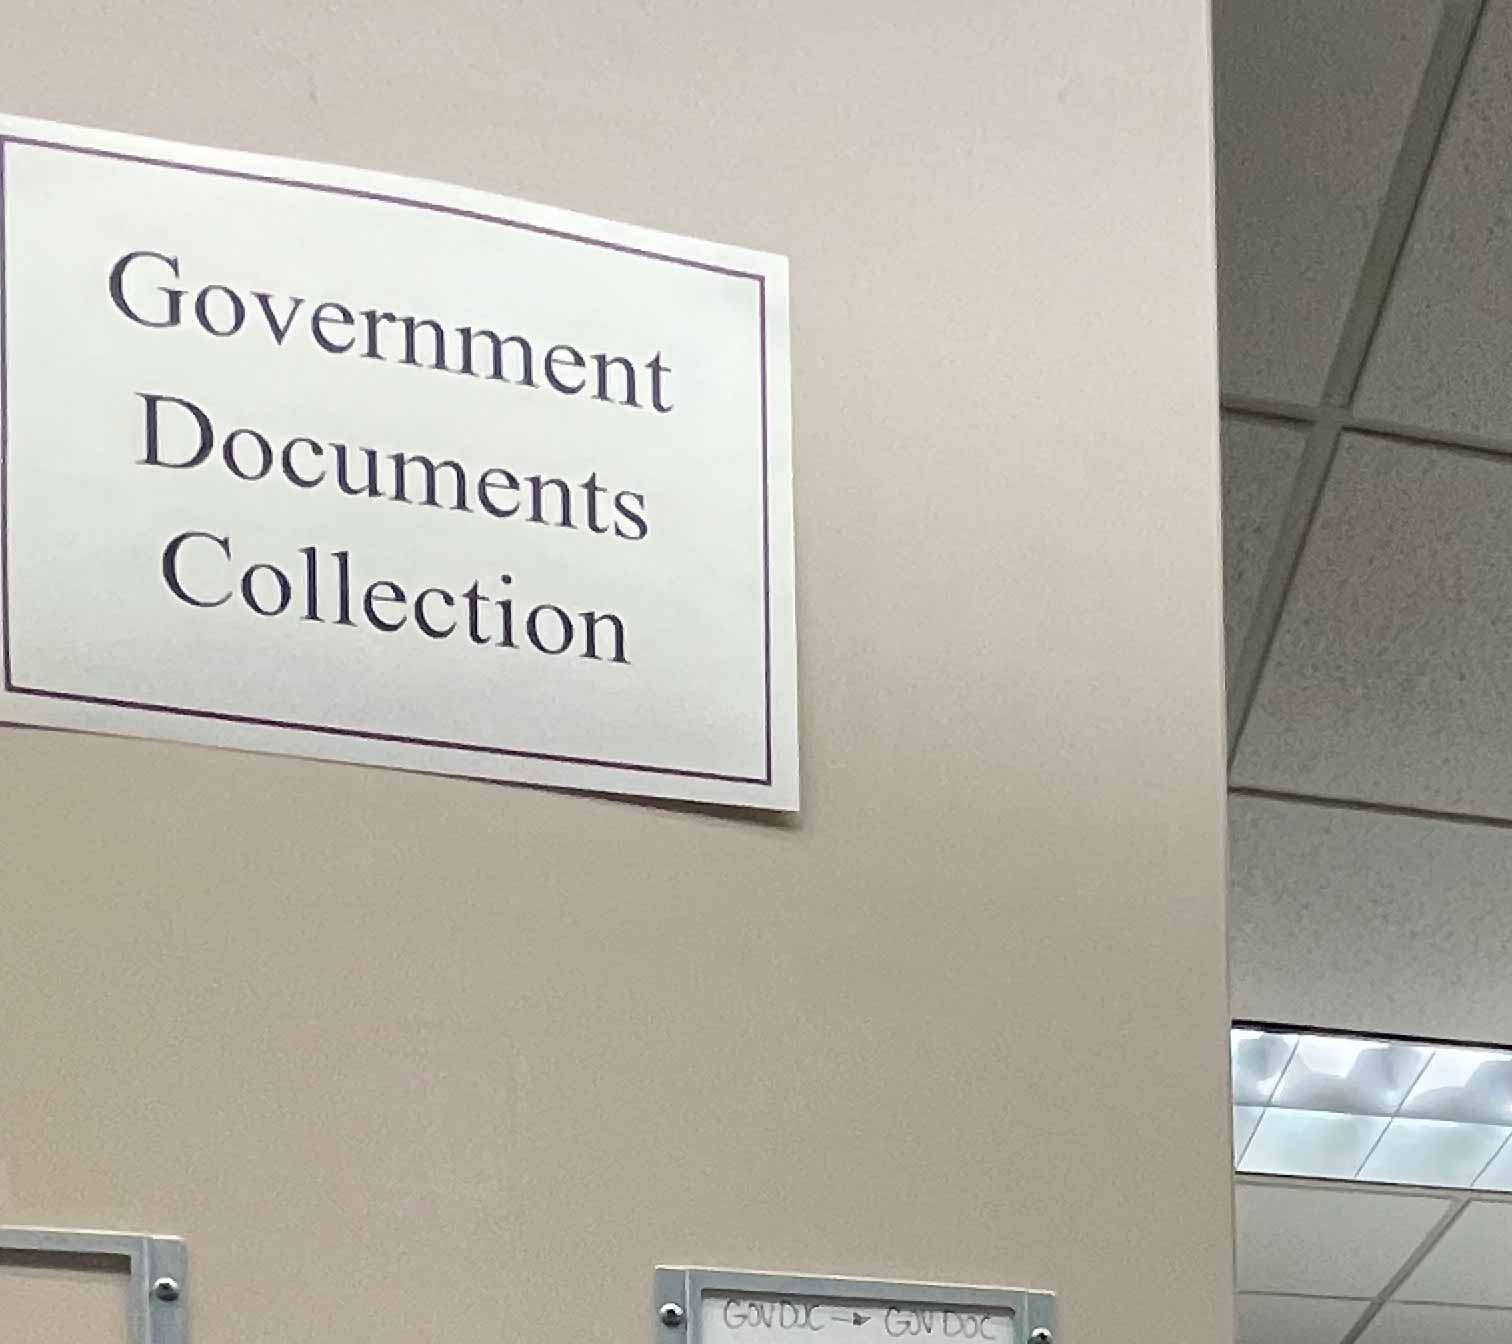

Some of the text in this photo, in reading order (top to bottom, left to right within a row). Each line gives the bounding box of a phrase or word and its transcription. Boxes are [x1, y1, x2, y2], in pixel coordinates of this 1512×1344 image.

[107, 250, 675, 413] Government
[134, 391, 651, 541] Documents
[160, 530, 632, 665] Collection
